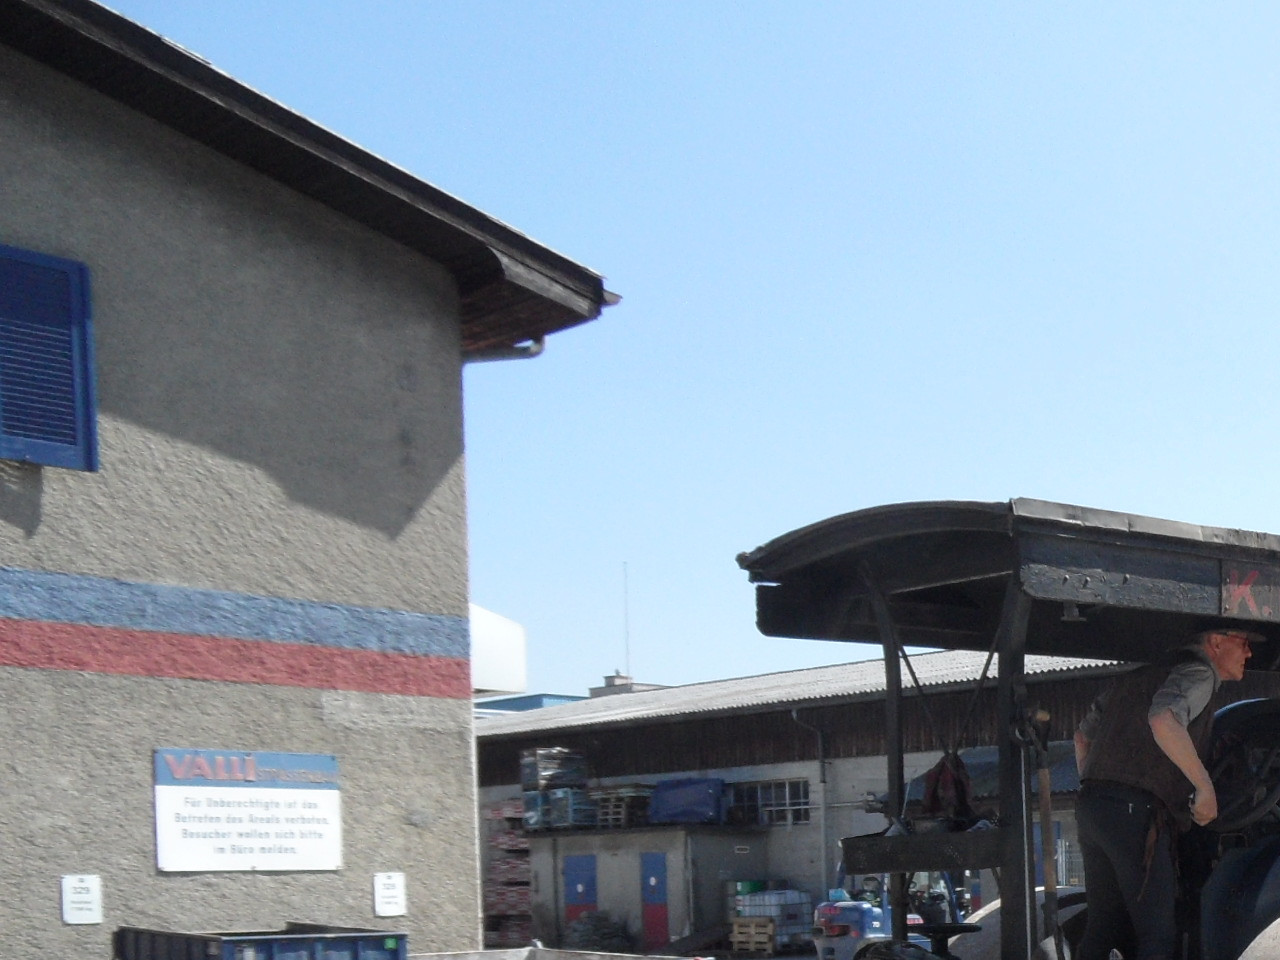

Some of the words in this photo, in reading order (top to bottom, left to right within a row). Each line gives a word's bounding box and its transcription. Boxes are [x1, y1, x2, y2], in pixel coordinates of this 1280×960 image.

[163, 753, 257, 783] VALLI
[184, 796, 202, 809] Für
[284, 799, 297, 809] ist
[174, 812, 222, 824] Betreten
[248, 813, 281, 824] Areals
[181, 828, 232, 839] Besucher
[236, 829, 270, 839] wollen
[274, 830, 296, 840] sich
[299, 830, 324, 840] bitte
[213, 845, 226, 855] im
[230, 844, 254, 855] Büro
